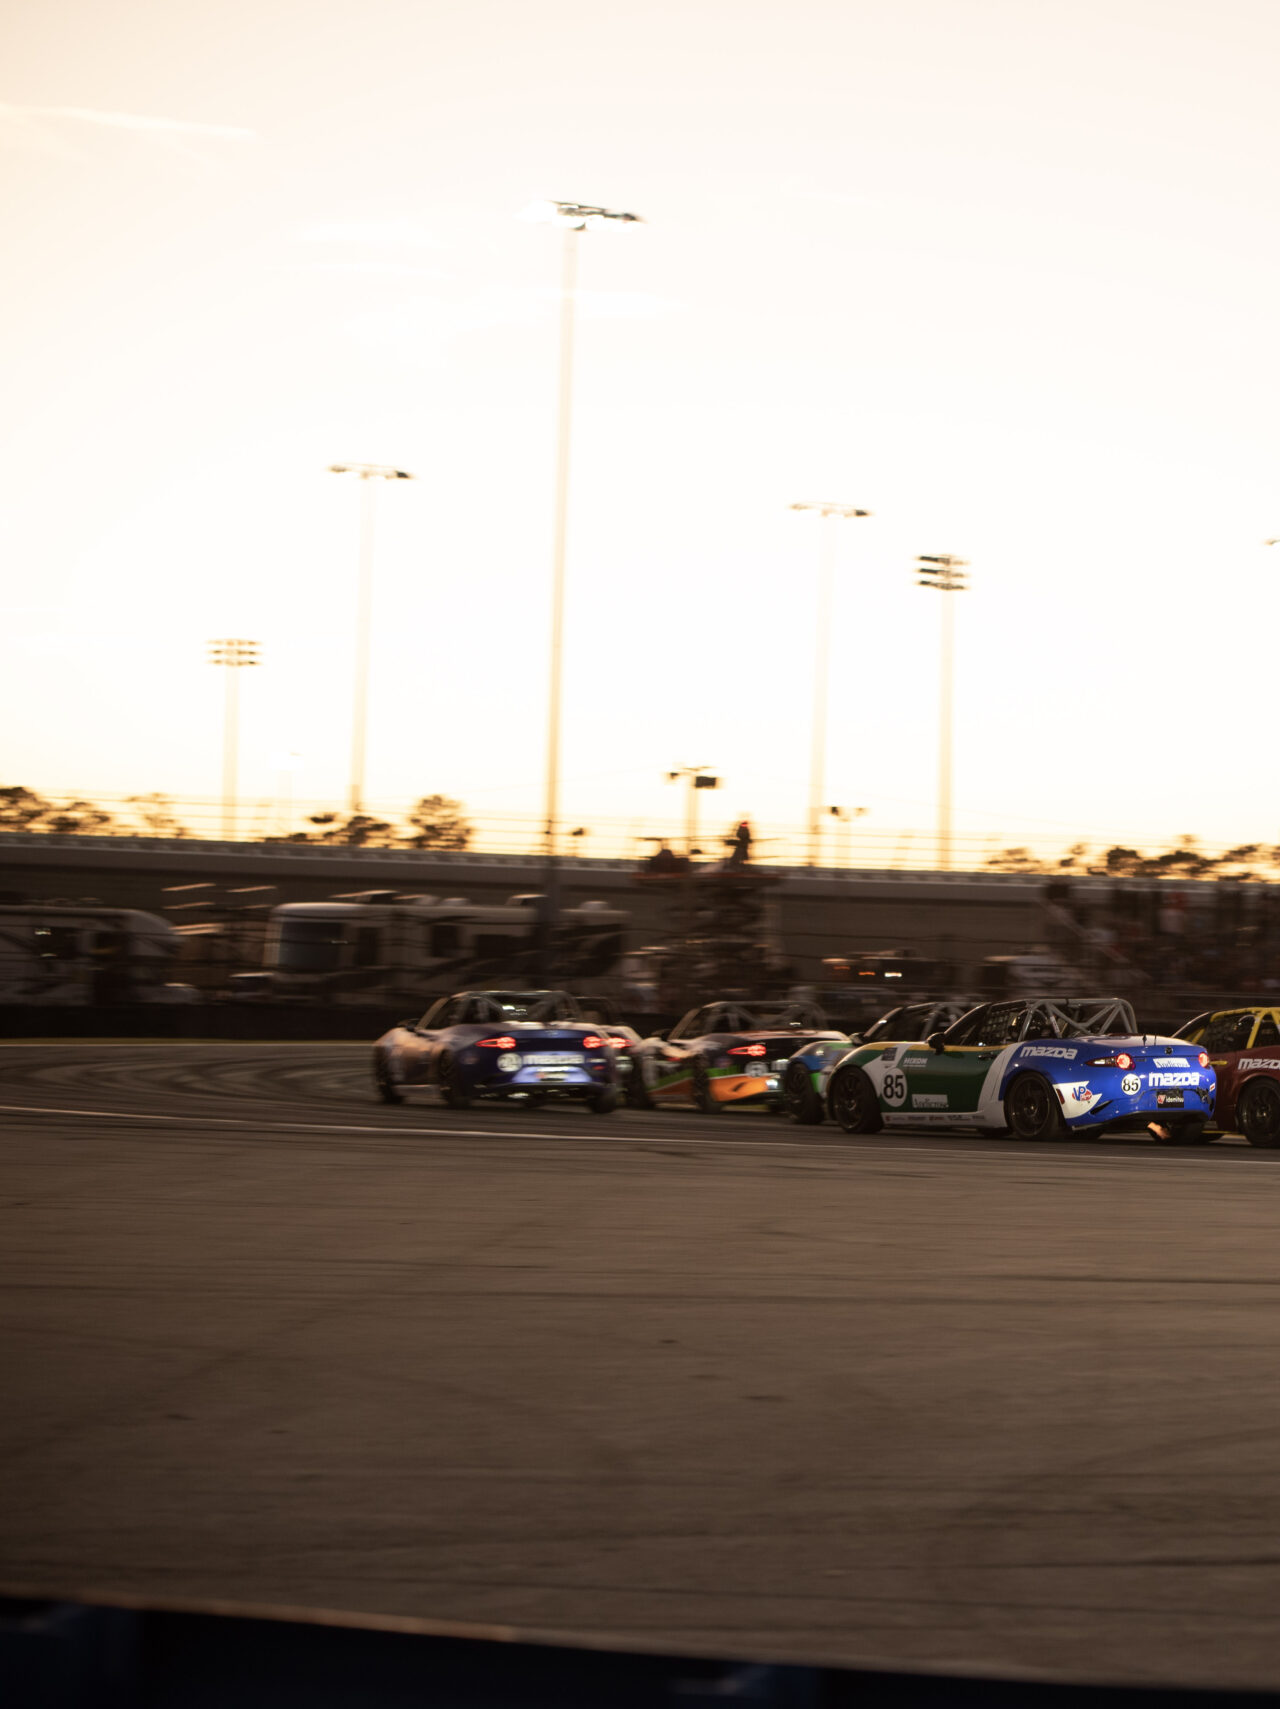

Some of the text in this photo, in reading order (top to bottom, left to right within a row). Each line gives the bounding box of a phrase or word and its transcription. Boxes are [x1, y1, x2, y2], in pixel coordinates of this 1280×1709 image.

[1020, 1046, 1078, 1060] mazda
[883, 1075, 904, 1099] 85
[1123, 1076, 1139, 1092] 85
[1148, 1072, 1200, 1087] mazda
